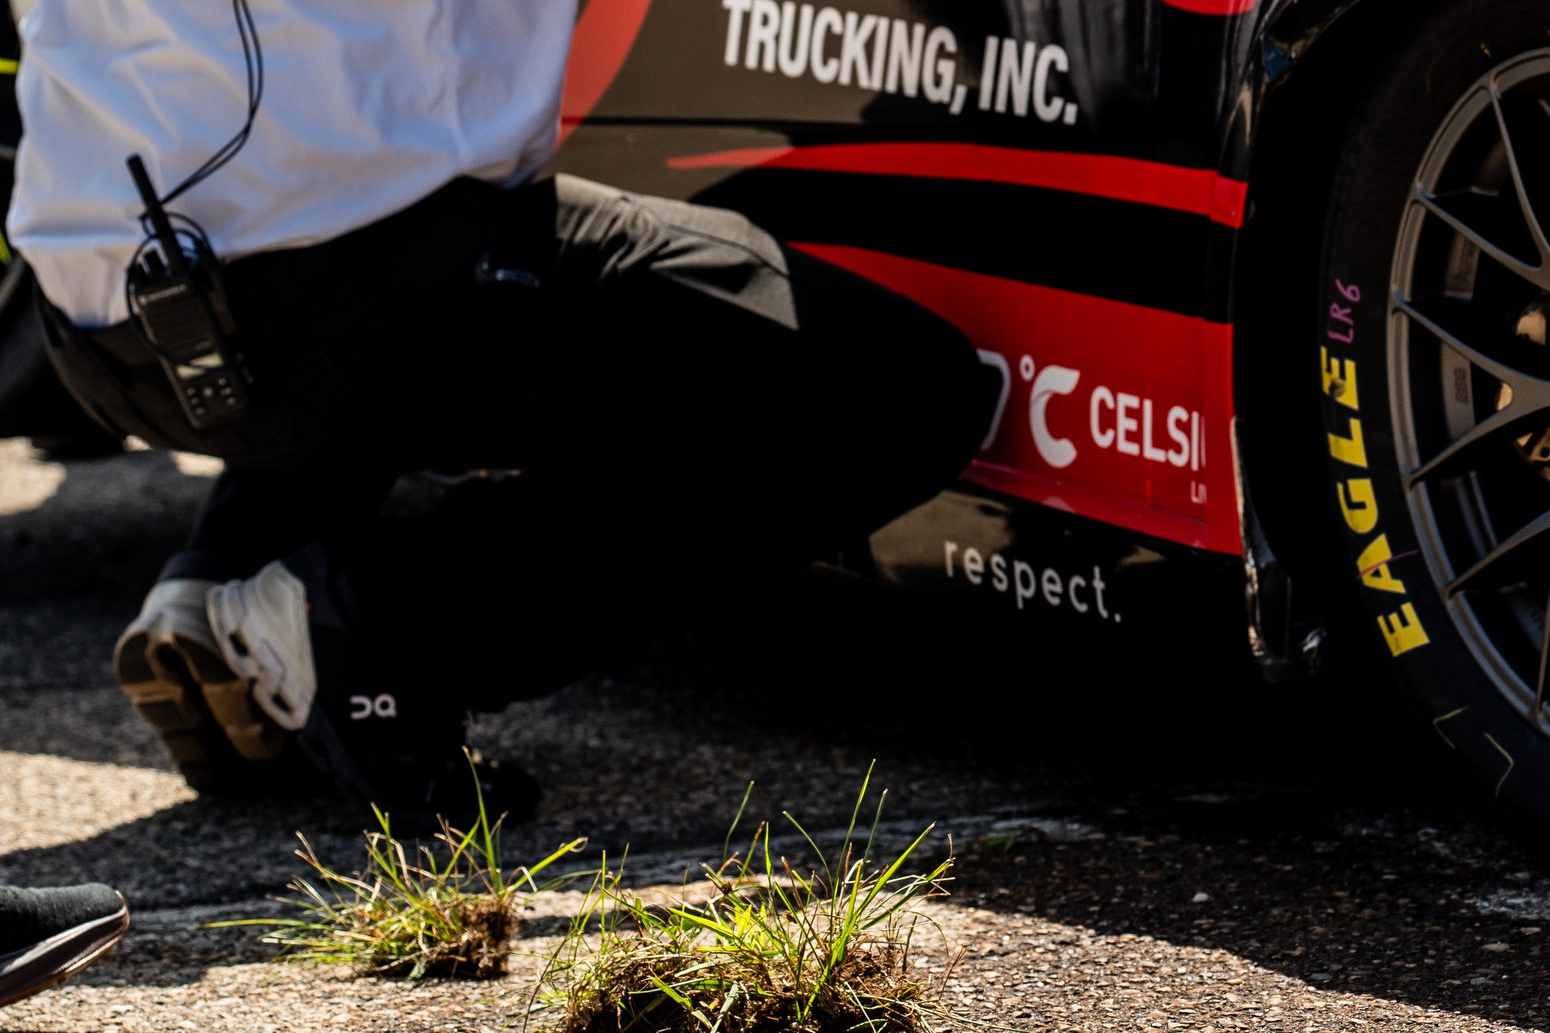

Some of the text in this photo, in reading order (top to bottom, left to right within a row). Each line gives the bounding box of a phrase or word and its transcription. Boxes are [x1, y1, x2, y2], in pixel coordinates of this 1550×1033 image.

[977, 33, 1079, 126] INC.
[1326, 277, 1362, 346] LR6
[1320, 345, 1431, 658] EAGLE
[943, 539, 1122, 623] respect.
